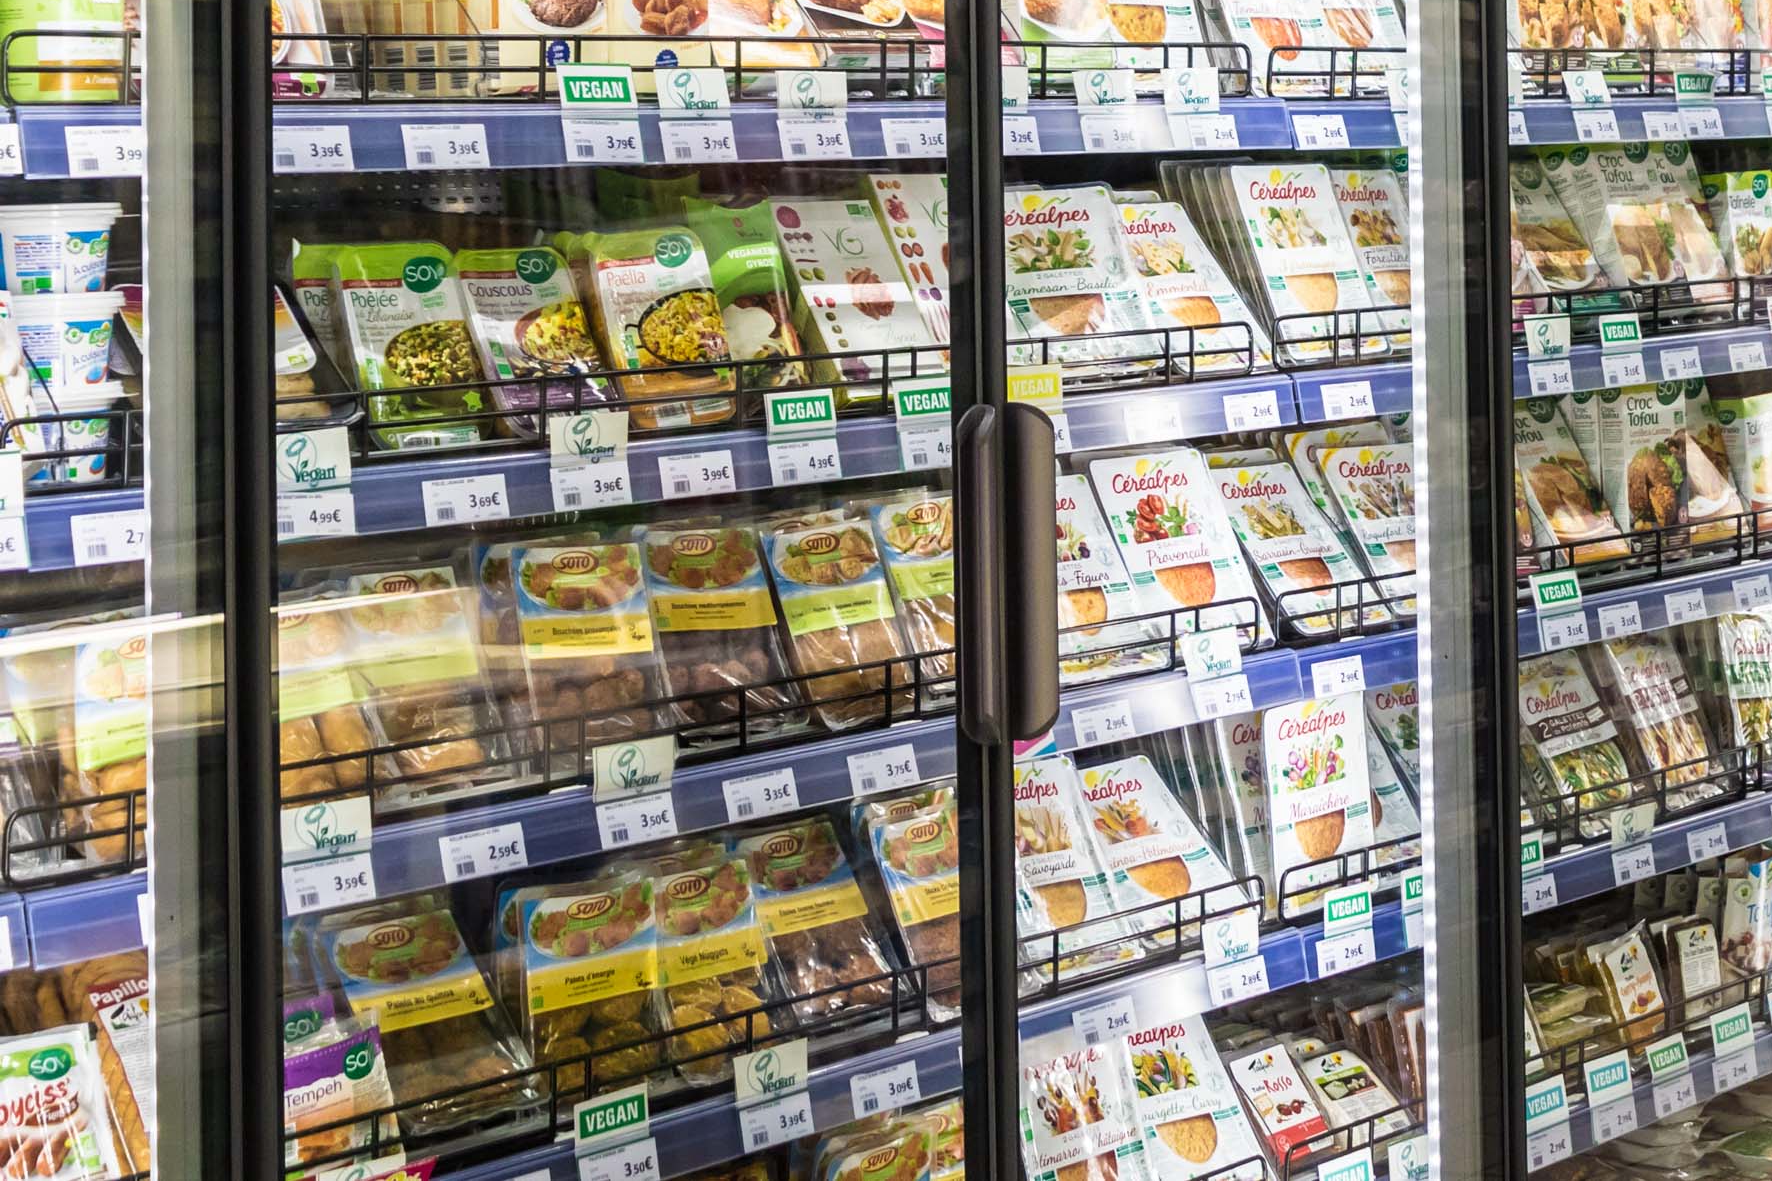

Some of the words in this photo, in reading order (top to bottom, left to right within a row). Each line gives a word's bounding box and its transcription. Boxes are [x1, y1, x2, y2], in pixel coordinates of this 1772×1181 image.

[569, 81, 625, 99] VEGAN
[1678, 75, 1712, 91] VEGAN
[1598, 154, 1624, 169] Croc
[1602, 168, 1634, 184] Tofou
[1250, 180, 1316, 205] Céréalpes
[1753, 179, 1767, 191] SOY
[657, 240, 692, 260] SOY
[405, 265, 444, 283] SOY
[517, 259, 555, 274] SOY
[351, 291, 399, 307] Poêlée
[468, 283, 532, 298] Couscous
[1605, 325, 1636, 339] VEGAN
[1012, 378, 1054, 397] VEGAN
[777, 399, 826, 421] VEGAN
[904, 391, 950, 412] VEGAN
[1627, 396, 1652, 412] Croc
[1628, 411, 1659, 427] Tofou
[702, 466, 730, 481] 3,99€
[1339, 459, 1411, 481] Céréalpes
[594, 478, 623, 493] 3,96€
[1112, 469, 1189, 494] Céréalpes
[469, 492, 500, 508] 3,69€
[1222, 482, 1287, 502] Céréalpes
[309, 509, 341, 524] 4,99€
[679, 537, 708, 551] SOTO
[806, 538, 832, 551] SOTO
[559, 556, 591, 569] SOTO
[1541, 583, 1574, 600] VEGAN
[1526, 690, 1581, 715] Céréalpes
[1279, 710, 1346, 741] Céréalpes
[1538, 722, 1552, 739] 2
[641, 811, 668, 827] 3,50€
[911, 824, 935, 839] SOTO
[488, 841, 520, 859] 2,59€
[768, 839, 795, 853] SOTO
[1024, 859, 1076, 878] Savoyarde
[334, 872, 368, 891] 3,59€
[673, 880, 703, 894] SOTO
[1331, 895, 1367, 919] VEGAN
[374, 929, 408, 943] SOTO
[1717, 1016, 1749, 1040] VEGAN
[30, 1054, 66, 1074] SOY
[1653, 1044, 1685, 1067] VEGAN
[1592, 1061, 1627, 1089] VEGAN
[1264, 1076, 1293, 1093] Rosso
[285, 1080, 342, 1109] Tempeh
[1527, 1087, 1563, 1115] VEGAN
[585, 1101, 639, 1133] VEGAN
